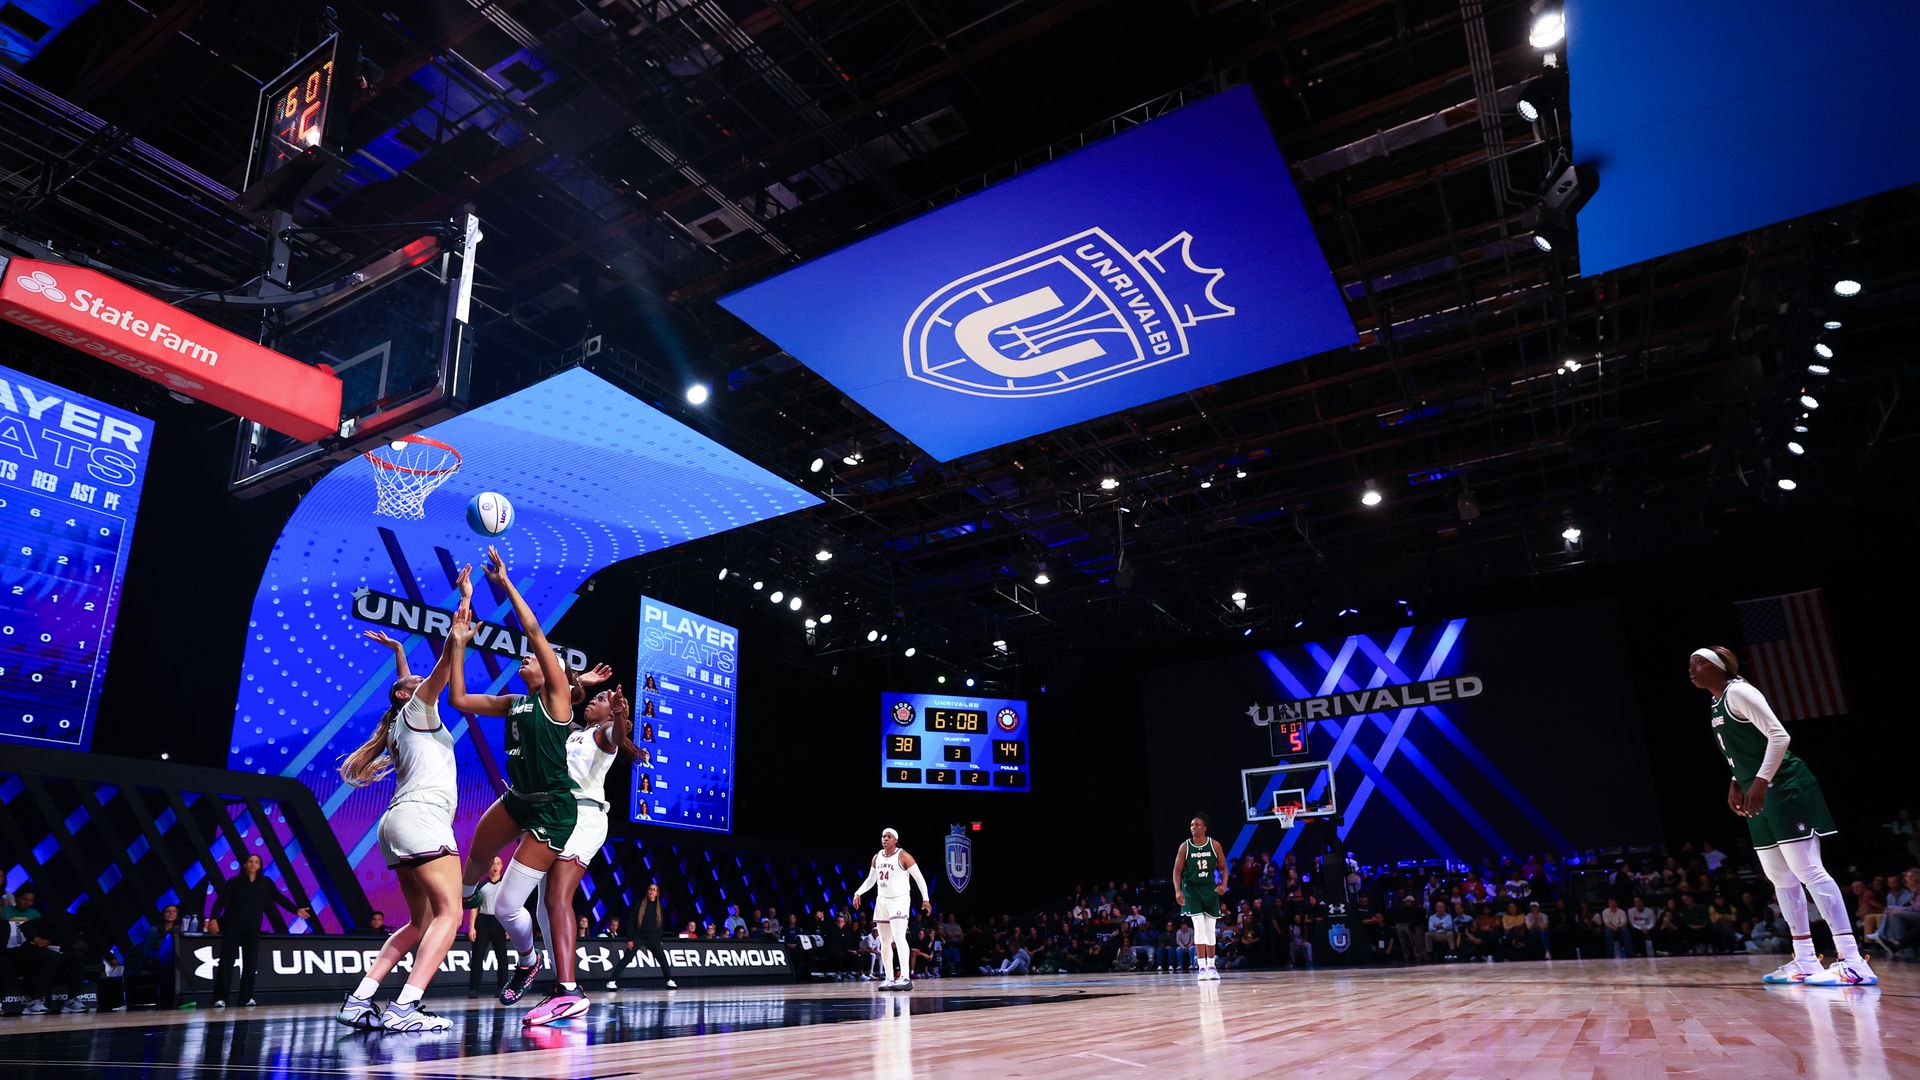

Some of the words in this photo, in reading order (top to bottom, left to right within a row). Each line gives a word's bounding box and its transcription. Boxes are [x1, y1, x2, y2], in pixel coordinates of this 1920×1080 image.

[1076, 243, 1171, 356] UNRIVALED
[31, 469, 58, 493] REB
[70, 482, 97, 504] AST
[104, 491, 121, 511] PF
[30, 508, 41, 517] 6
[66, 519, 76, 527] 4
[100, 528, 110, 536] 0
[21, 547, 32, 556] 6
[57, 556, 69, 565] 2
[95, 565, 101, 573] 1
[12, 586, 24, 595] 2
[52, 595, 58, 603] 1
[84, 602, 95, 611] 2
[357, 595, 588, 672] UNRVALD
[645, 605, 735, 651] PLAYER
[3, 626, 15, 635] 0
[40, 633, 52, 642] 0
[79, 641, 85, 649] 1
[644, 627, 735, 673] STATS
[32, 673, 43, 682] 0
[71, 680, 77, 688] 1
[935, 700, 980, 708] UNRIVALED
[1253, 676, 1483, 727] UNRIVALED
[22, 714, 34, 723] 0
[59, 720, 70, 728] 0
[935, 712, 978, 731] 6:08
[895, 738, 913, 752] 38
[1001, 743, 1018, 757] 44
[1290, 732, 1302, 751] 5
[955, 750, 961, 759] 3
[901, 771, 907, 781] 0
[938, 772, 944, 782] 2
[972, 773, 978, 783] 2
[1010, 775, 1014, 784] 1
[1197, 860, 1208, 870] 12
[880, 871, 889, 881] 24
[705, 950, 787, 967] ARMOUR
